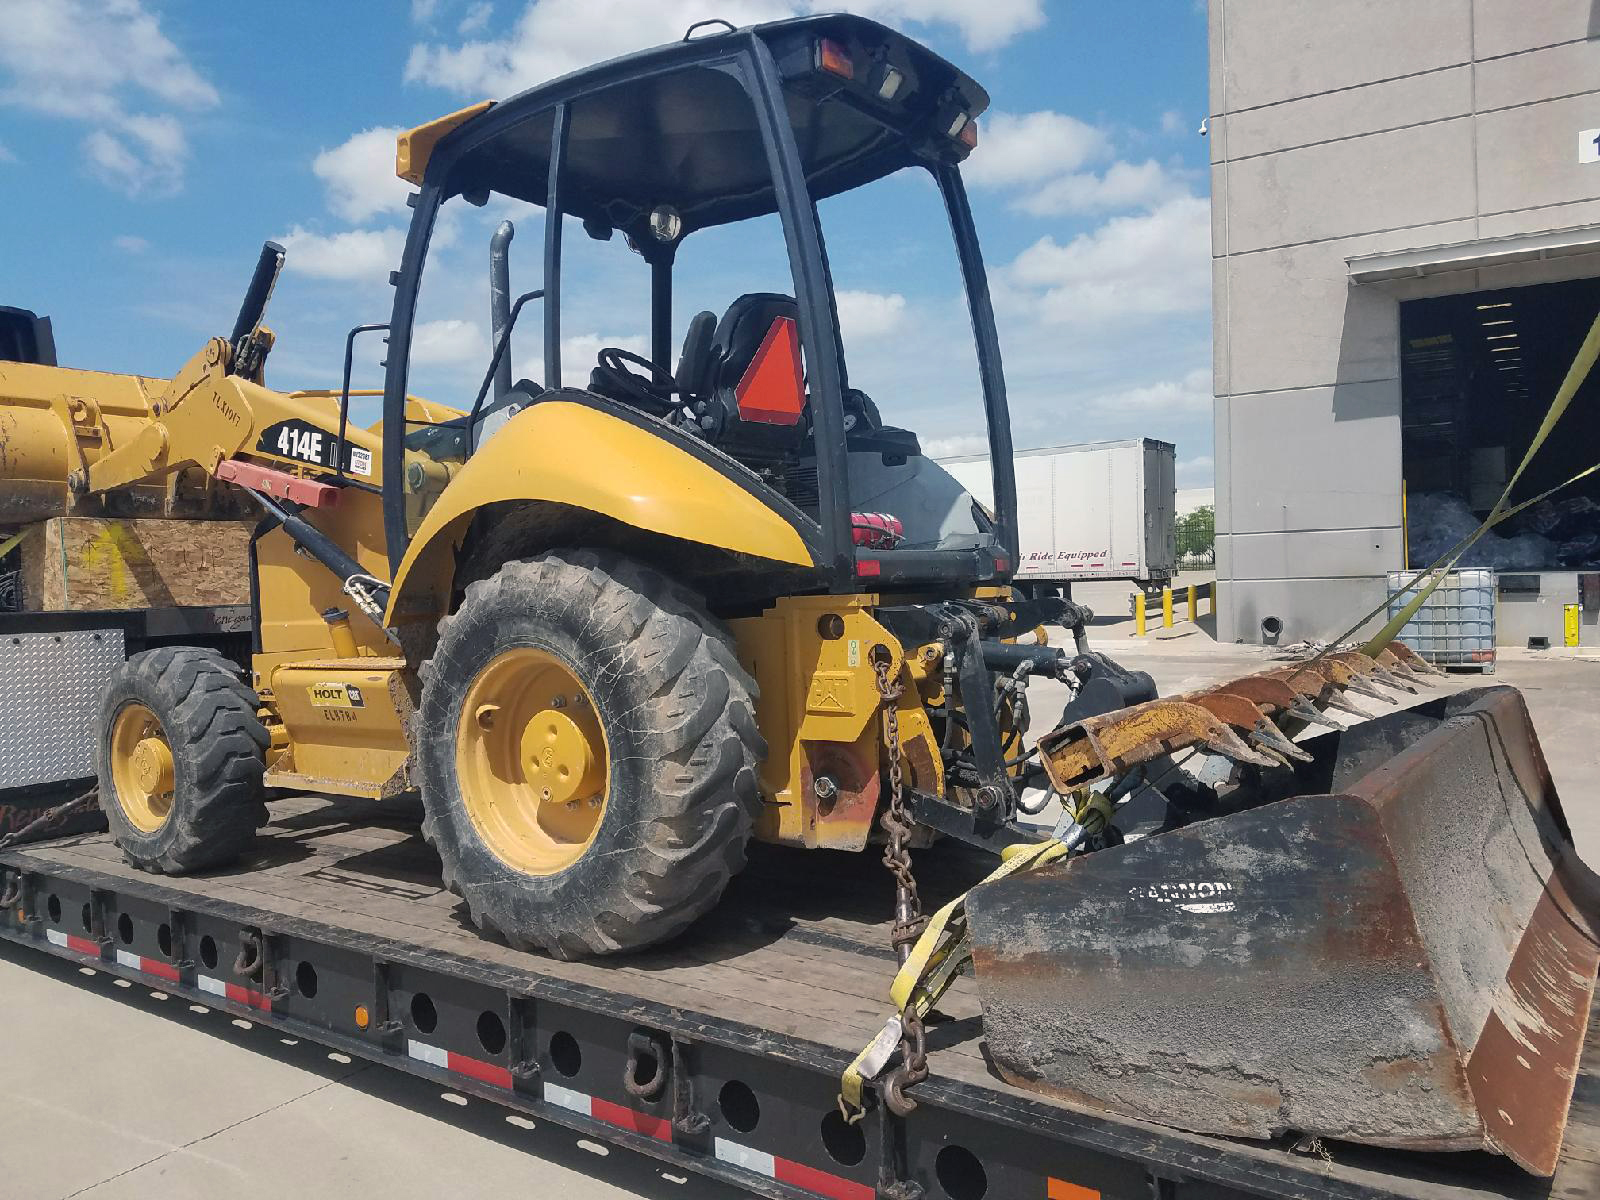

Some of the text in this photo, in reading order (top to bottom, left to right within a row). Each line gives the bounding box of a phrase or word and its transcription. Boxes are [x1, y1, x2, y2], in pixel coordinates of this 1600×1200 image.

[277, 426, 322, 464] 414E
[1029, 551, 1053, 561] Ride
[1057, 549, 1108, 561] Equipped
[313, 689, 343, 699] HOLT
